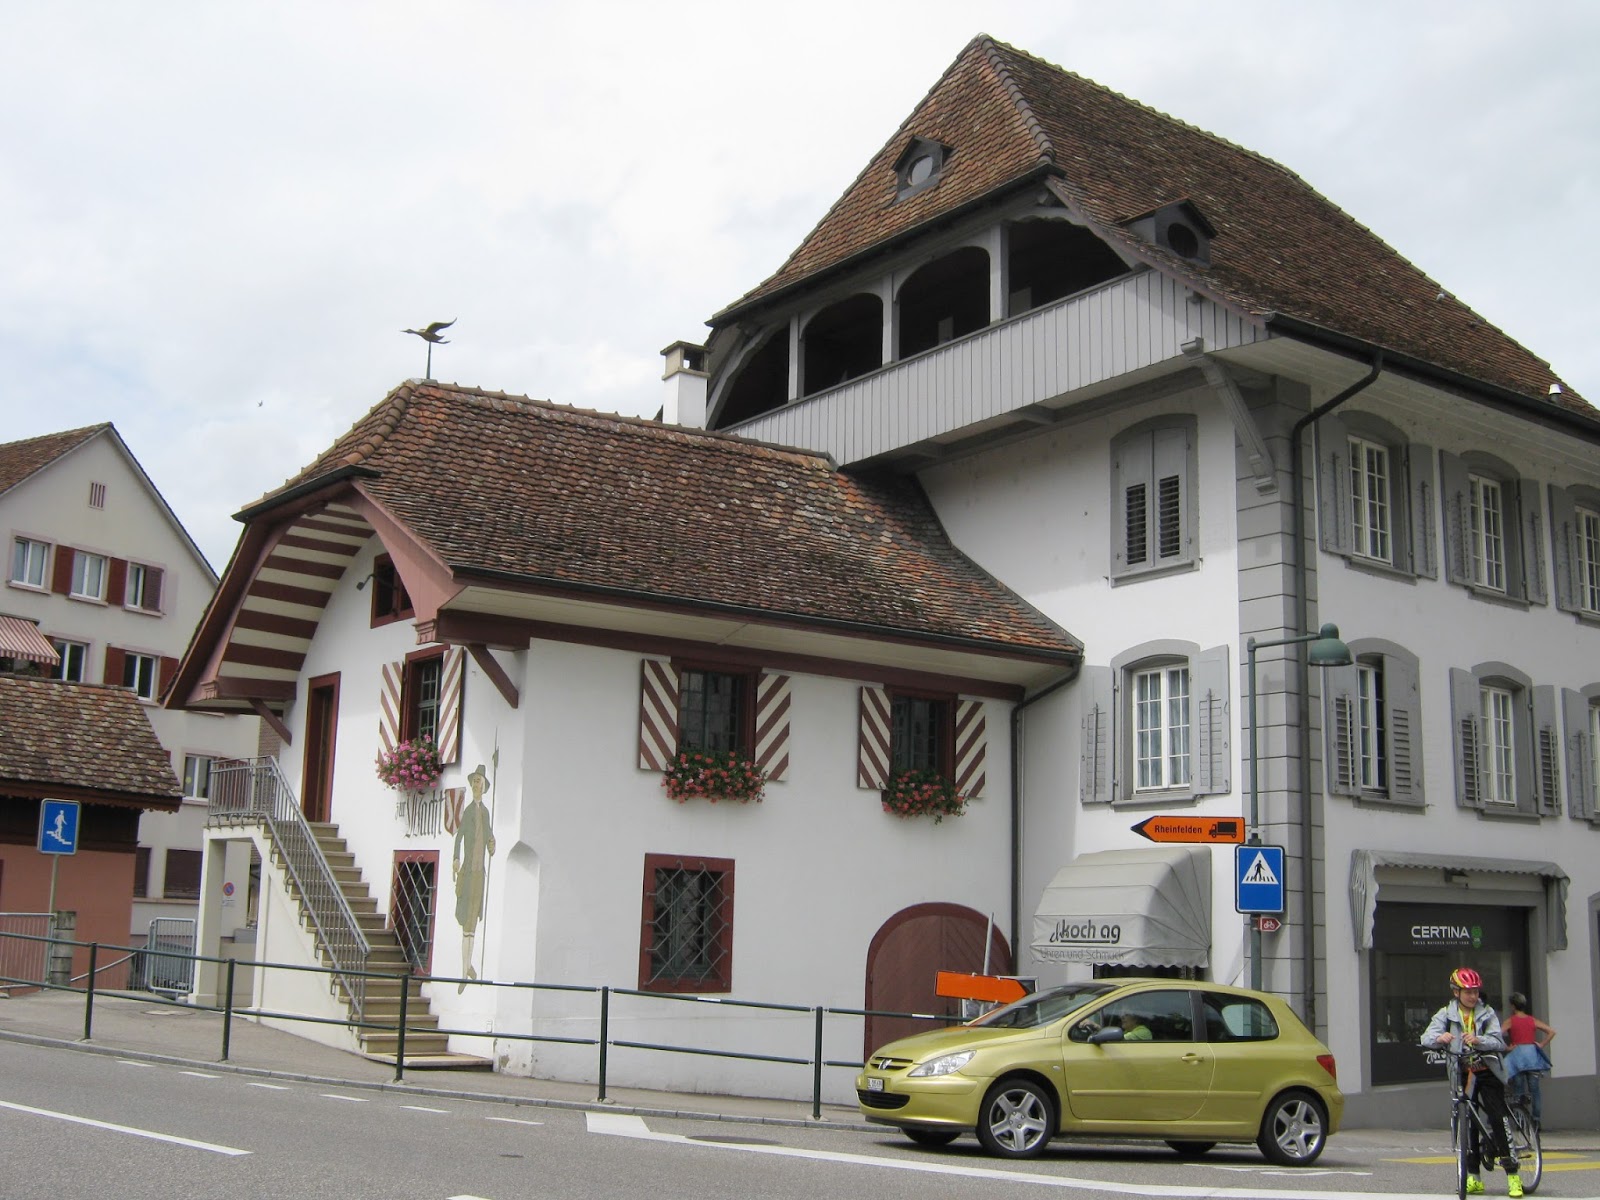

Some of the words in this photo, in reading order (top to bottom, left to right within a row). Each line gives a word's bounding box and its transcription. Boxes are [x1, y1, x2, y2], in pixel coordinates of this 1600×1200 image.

[1154, 824, 1203, 834] Rheinfelden
[1100, 924, 1121, 944] ag
[1411, 925, 1470, 939] CERTINA
[1041, 948, 1065, 959] Uhren
[1067, 948, 1084, 959] und
[1086, 948, 1125, 960] Schmuck
